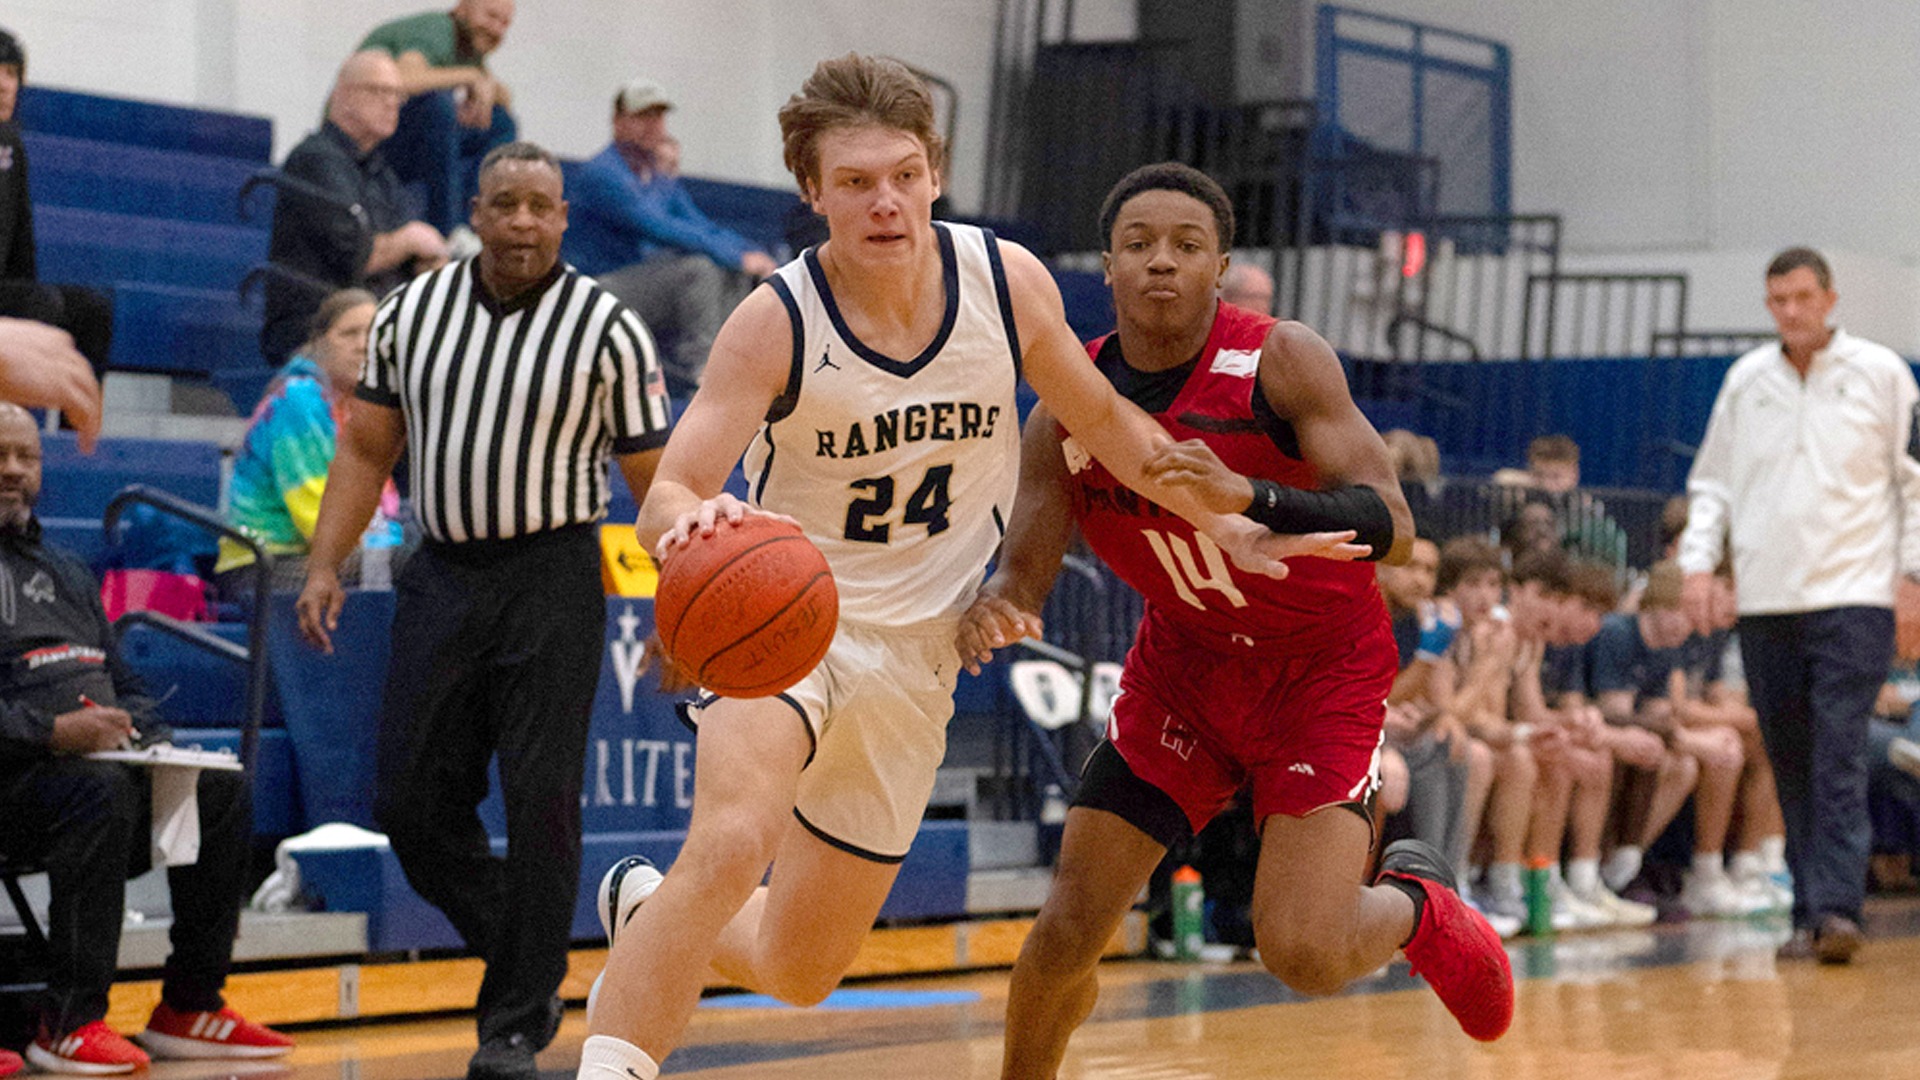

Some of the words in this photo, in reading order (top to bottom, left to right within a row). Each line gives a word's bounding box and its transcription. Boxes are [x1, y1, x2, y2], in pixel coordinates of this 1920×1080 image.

[815, 402, 1000, 458] RANGERS
[844, 463, 955, 544] 24
[1140, 529, 1249, 611] 14
[743, 592, 822, 672] JESUIT
[580, 738, 694, 809] RITE
